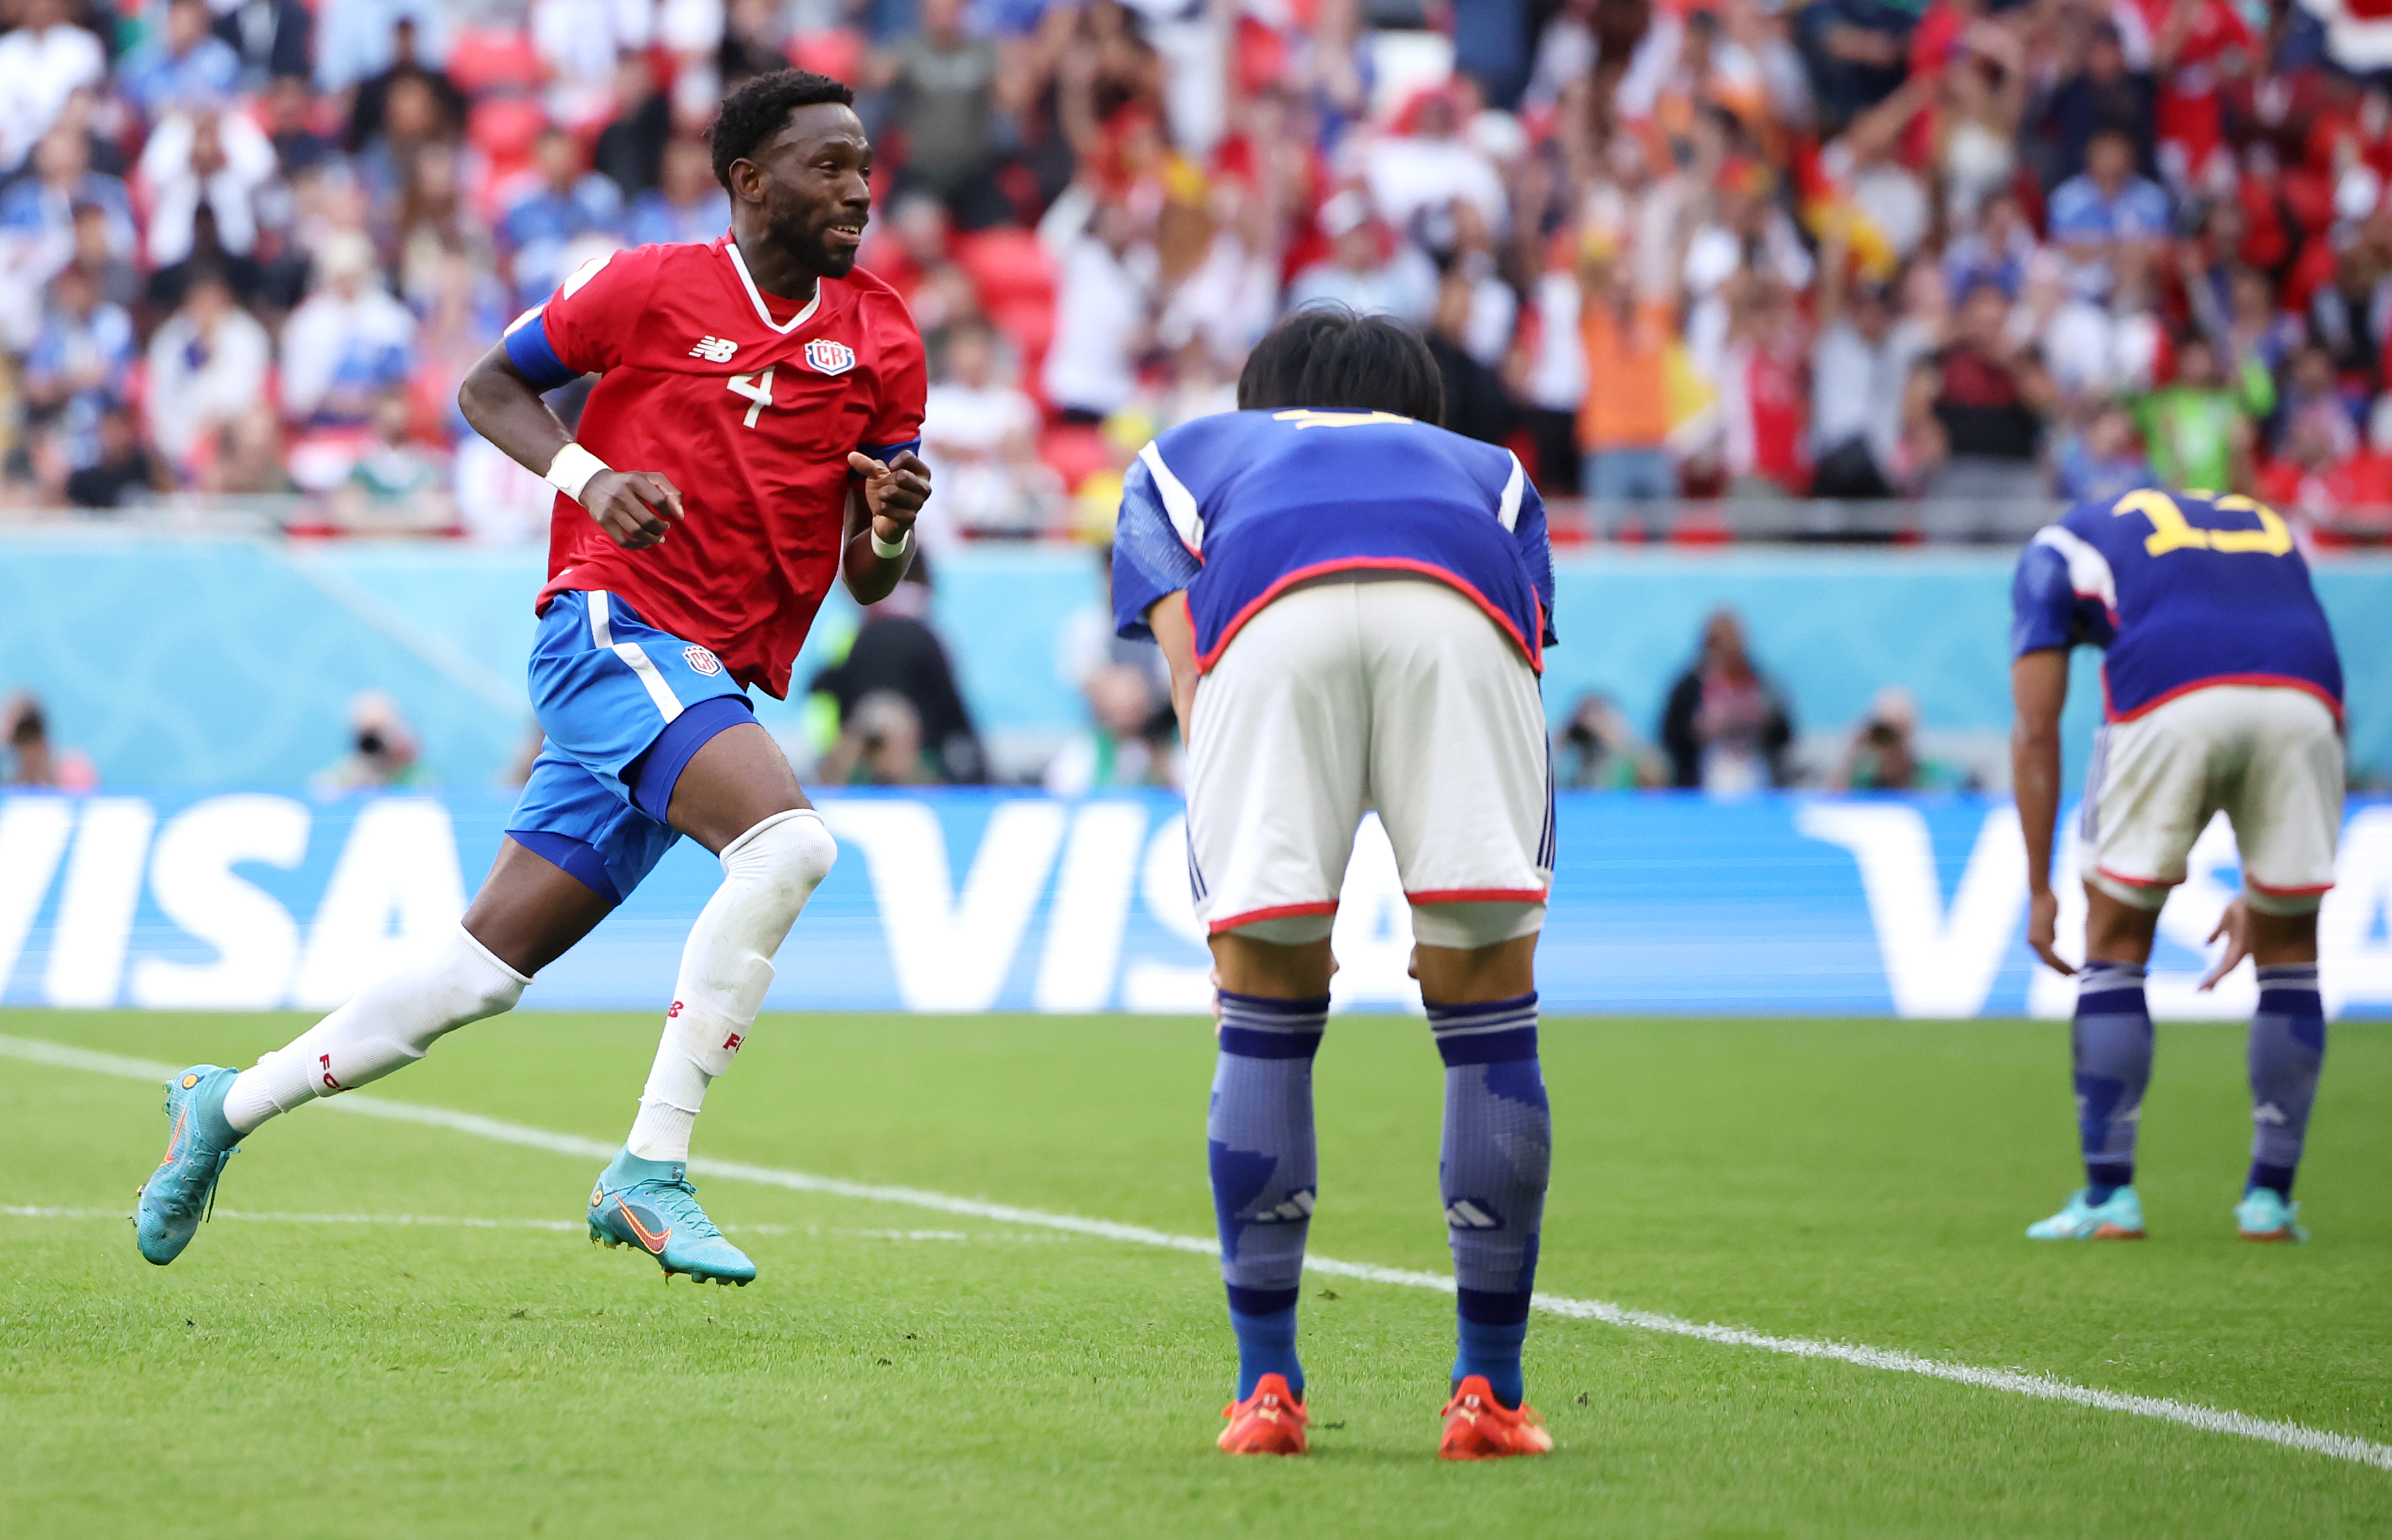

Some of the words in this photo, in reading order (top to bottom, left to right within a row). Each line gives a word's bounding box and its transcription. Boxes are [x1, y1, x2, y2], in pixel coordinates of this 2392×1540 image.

[688, 335, 738, 363] NB
[816, 345, 844, 366] CR
[726, 365, 775, 429] 4
[320, 1054, 354, 1091] FC
